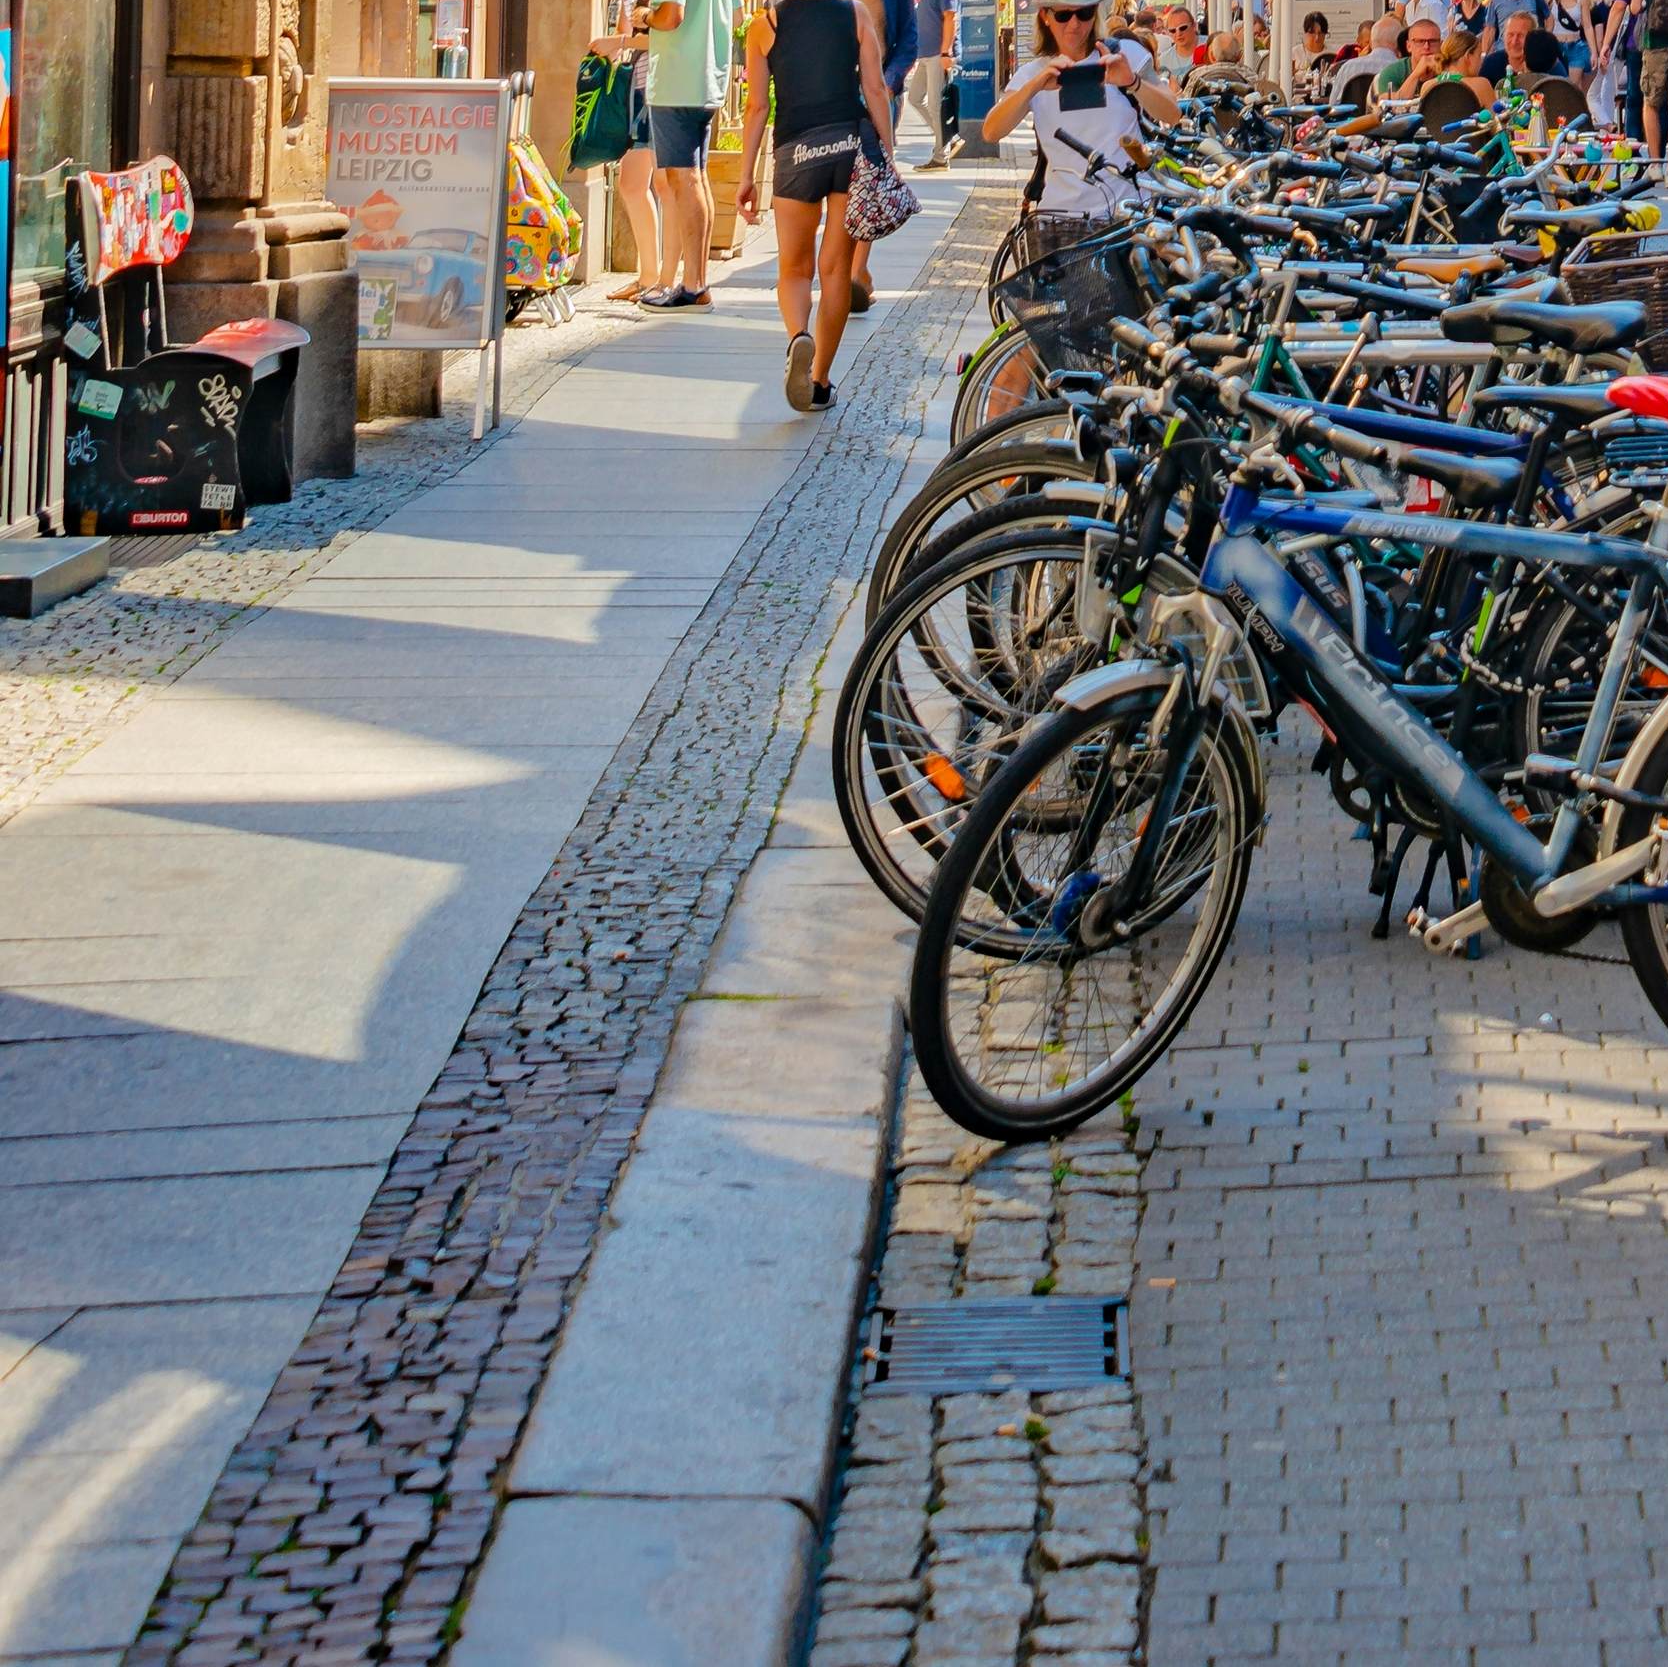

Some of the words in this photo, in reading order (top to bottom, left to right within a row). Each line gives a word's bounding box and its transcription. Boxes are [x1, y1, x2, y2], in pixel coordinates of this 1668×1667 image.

[337, 130, 460, 156] MUSEUM
[793, 133, 862, 165] Abercrombi
[336, 158, 433, 182] LEIPZIG
[141, 512, 188, 525] BURTON
[1319, 632, 1449, 767] Prince
